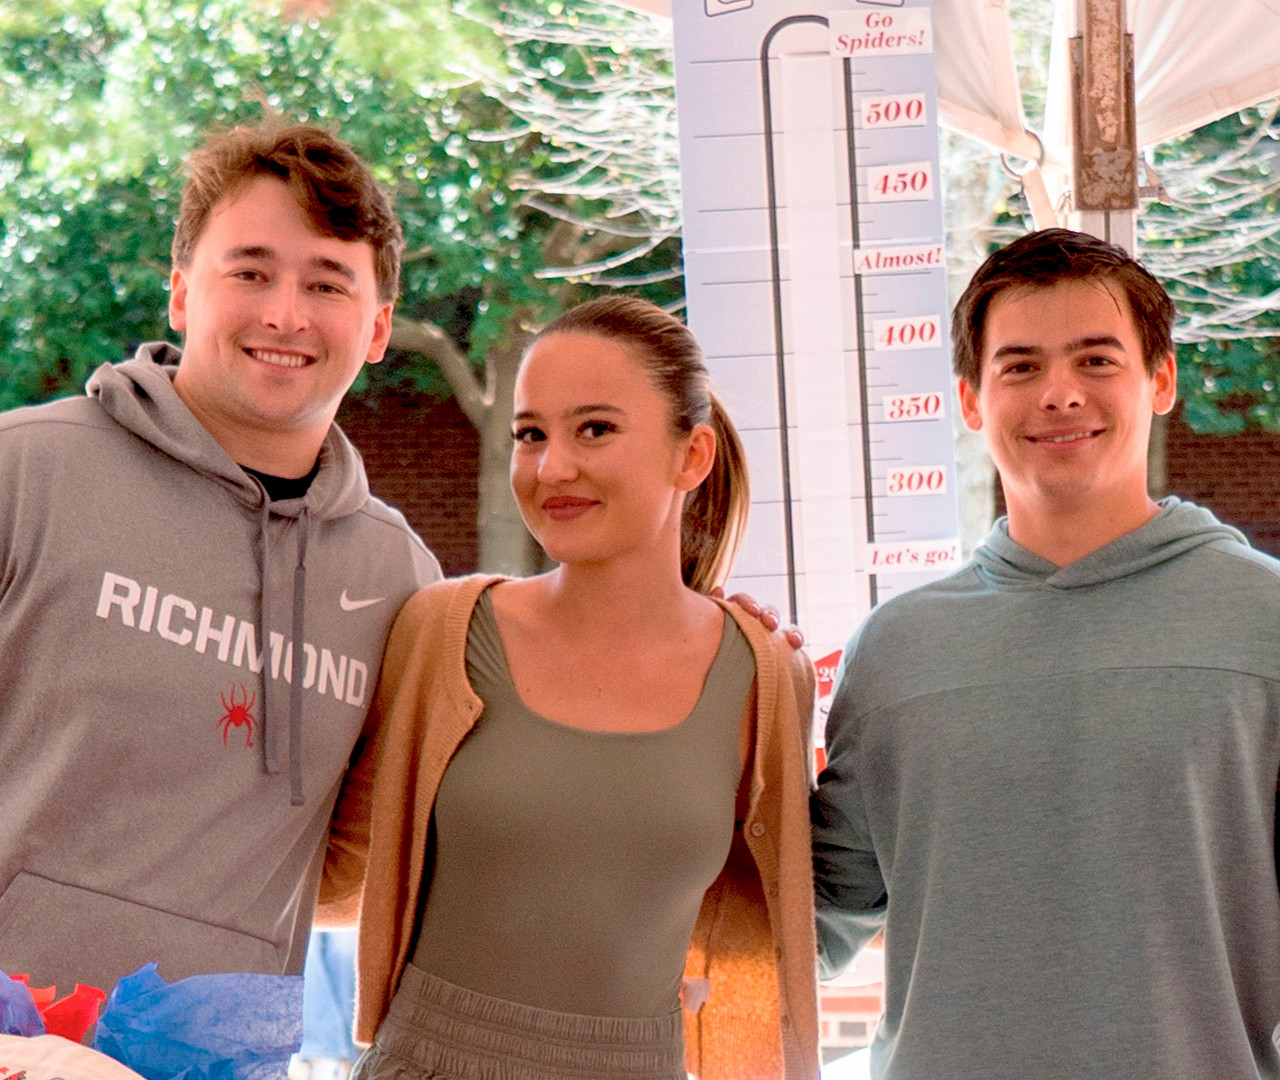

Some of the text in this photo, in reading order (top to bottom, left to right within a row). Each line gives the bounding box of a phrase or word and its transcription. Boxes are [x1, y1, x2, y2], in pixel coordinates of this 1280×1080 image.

[865, 12, 893, 29] Go
[836, 30, 925, 54] Spiders!
[866, 99, 923, 124] 500
[874, 171, 928, 195] 450
[858, 248, 942, 271] Almost!
[879, 321, 936, 346] 400
[889, 395, 940, 420] 350
[888, 469, 944, 493] 300
[871, 545, 957, 567] Let's go!
[95, 571, 369, 708] RICHMOND
